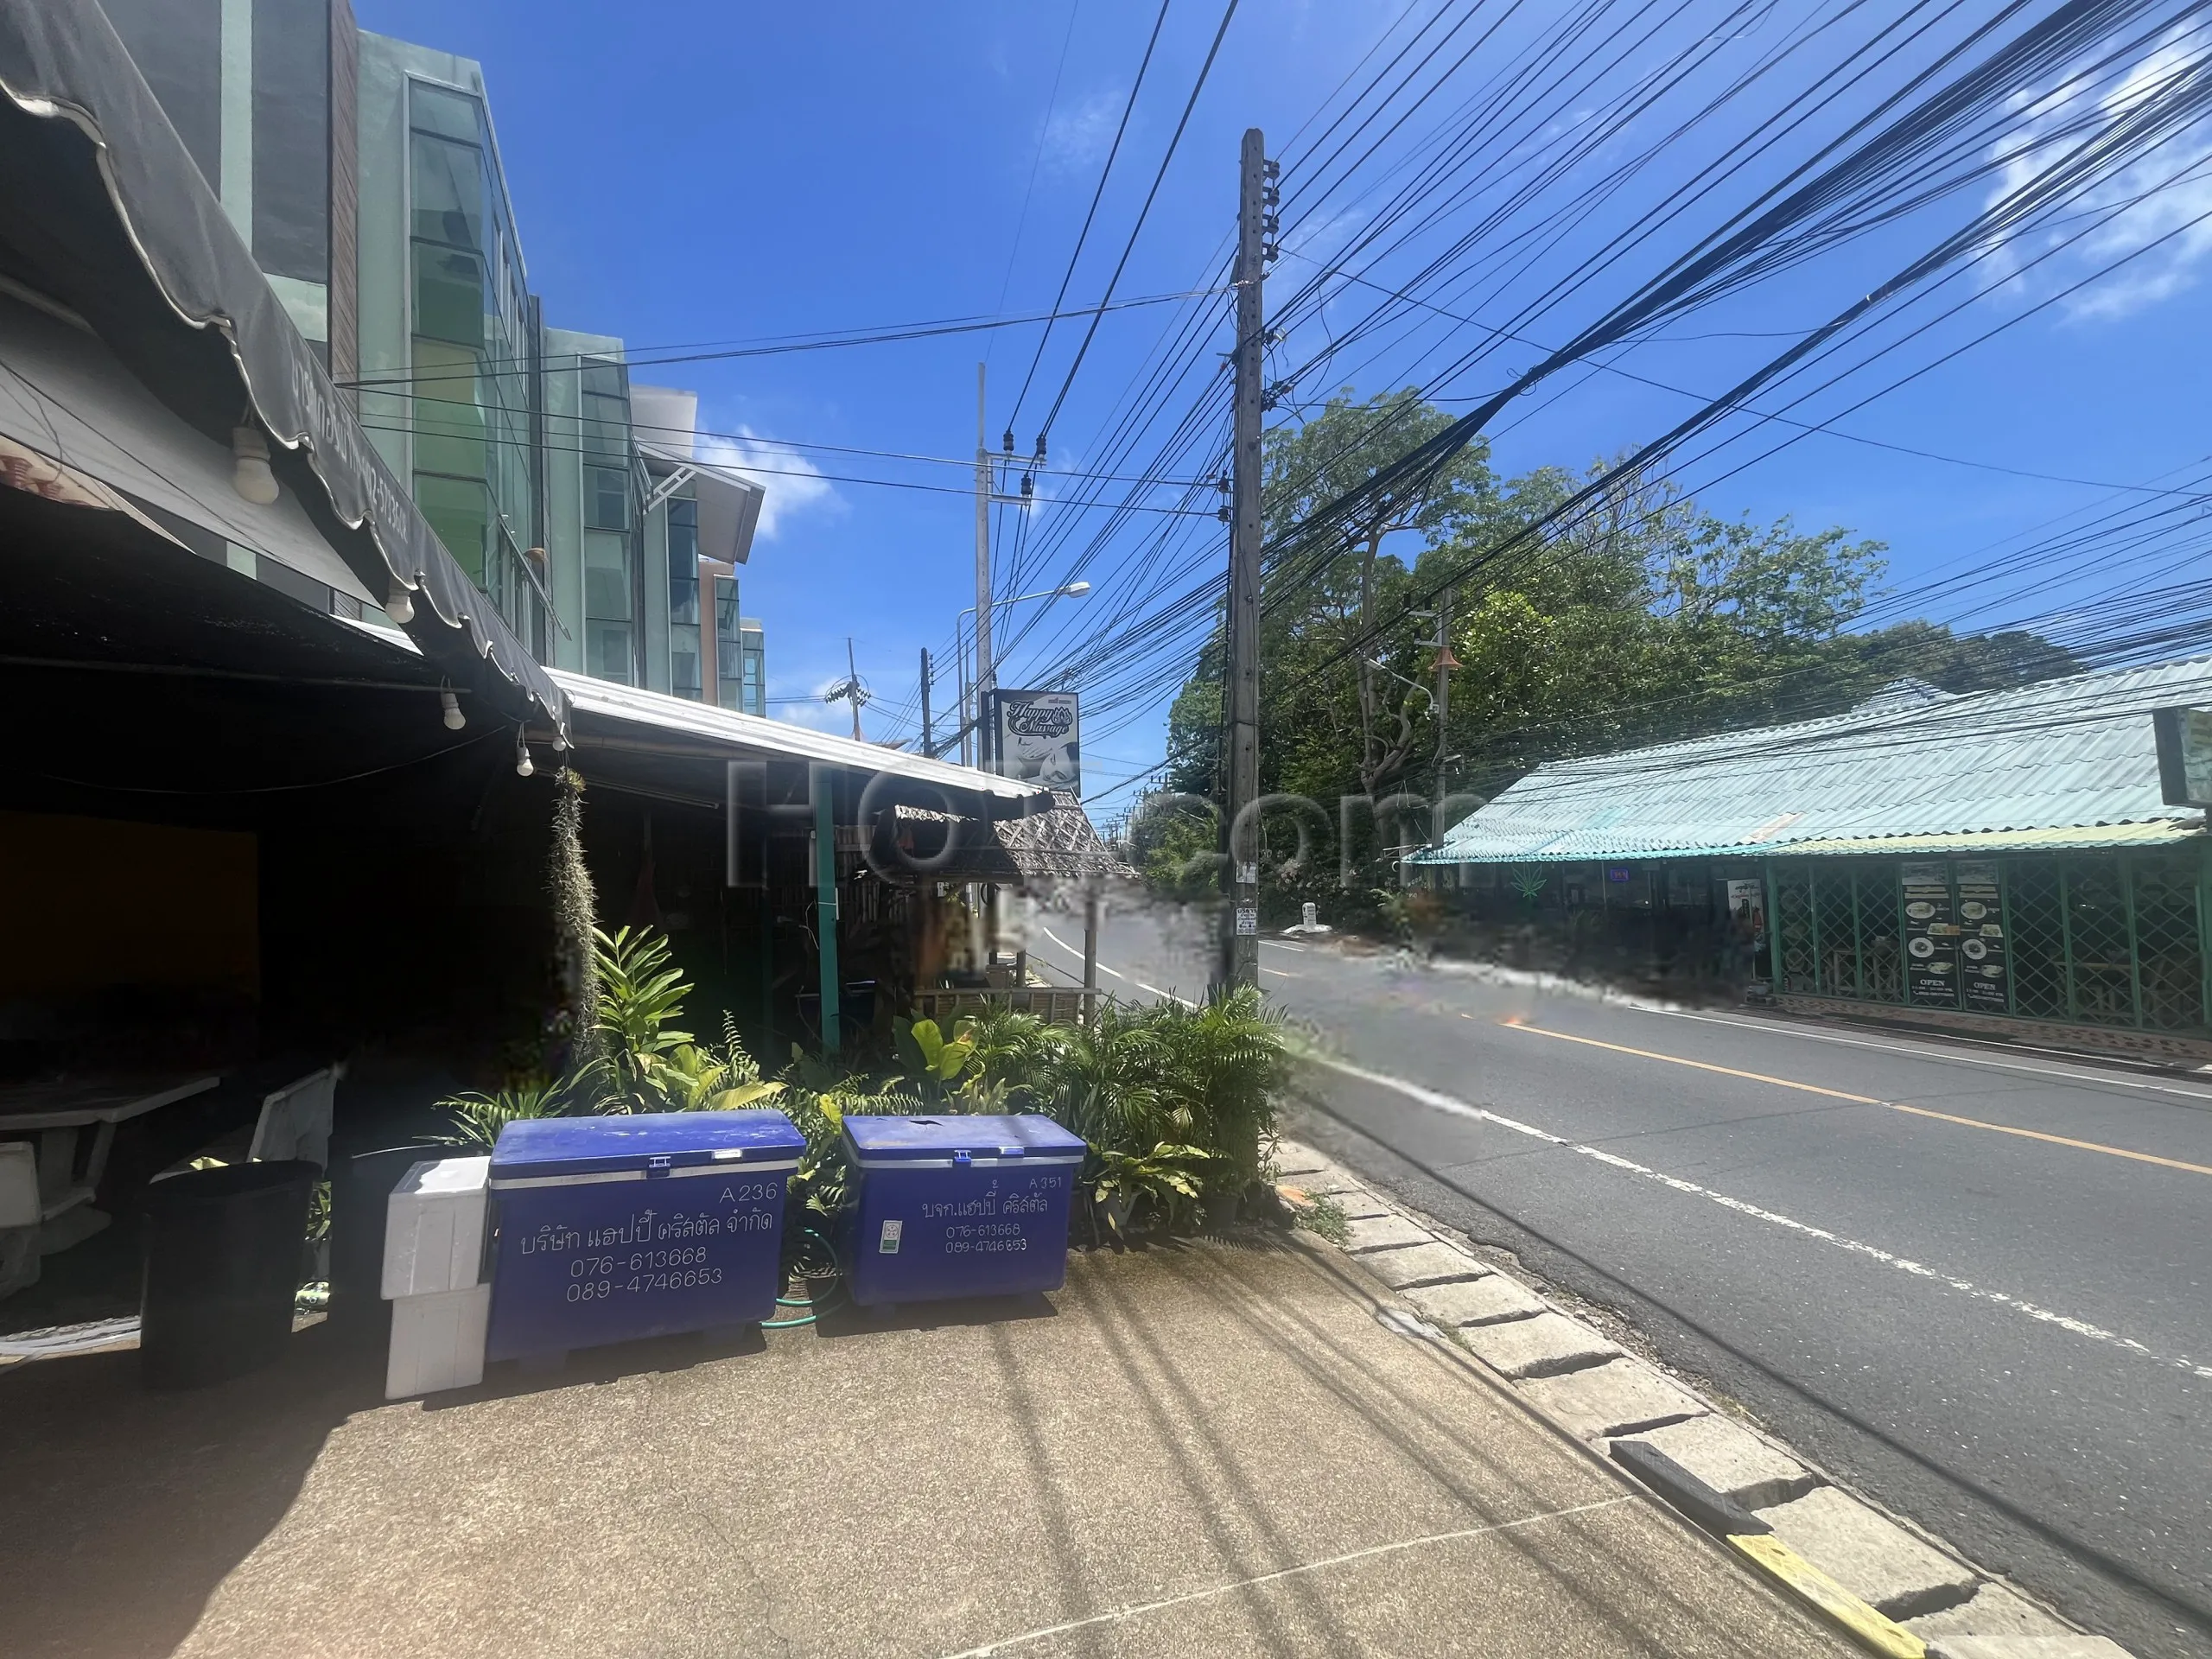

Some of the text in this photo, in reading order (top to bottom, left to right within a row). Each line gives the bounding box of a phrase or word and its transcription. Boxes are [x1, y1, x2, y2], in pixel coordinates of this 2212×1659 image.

[1007, 701, 1054, 723] Happy
[1016, 719, 1069, 737] Massage
[719, 1182, 779, 1204] A236
[520, 1224, 581, 1255] บริษัท
[726, 1207, 772, 1234] จำกัด
[945, 1224, 1020, 1239] 076-613668
[570, 1246, 707, 1278] 076-613668
[566, 1268, 723, 1302] 089-4746653
